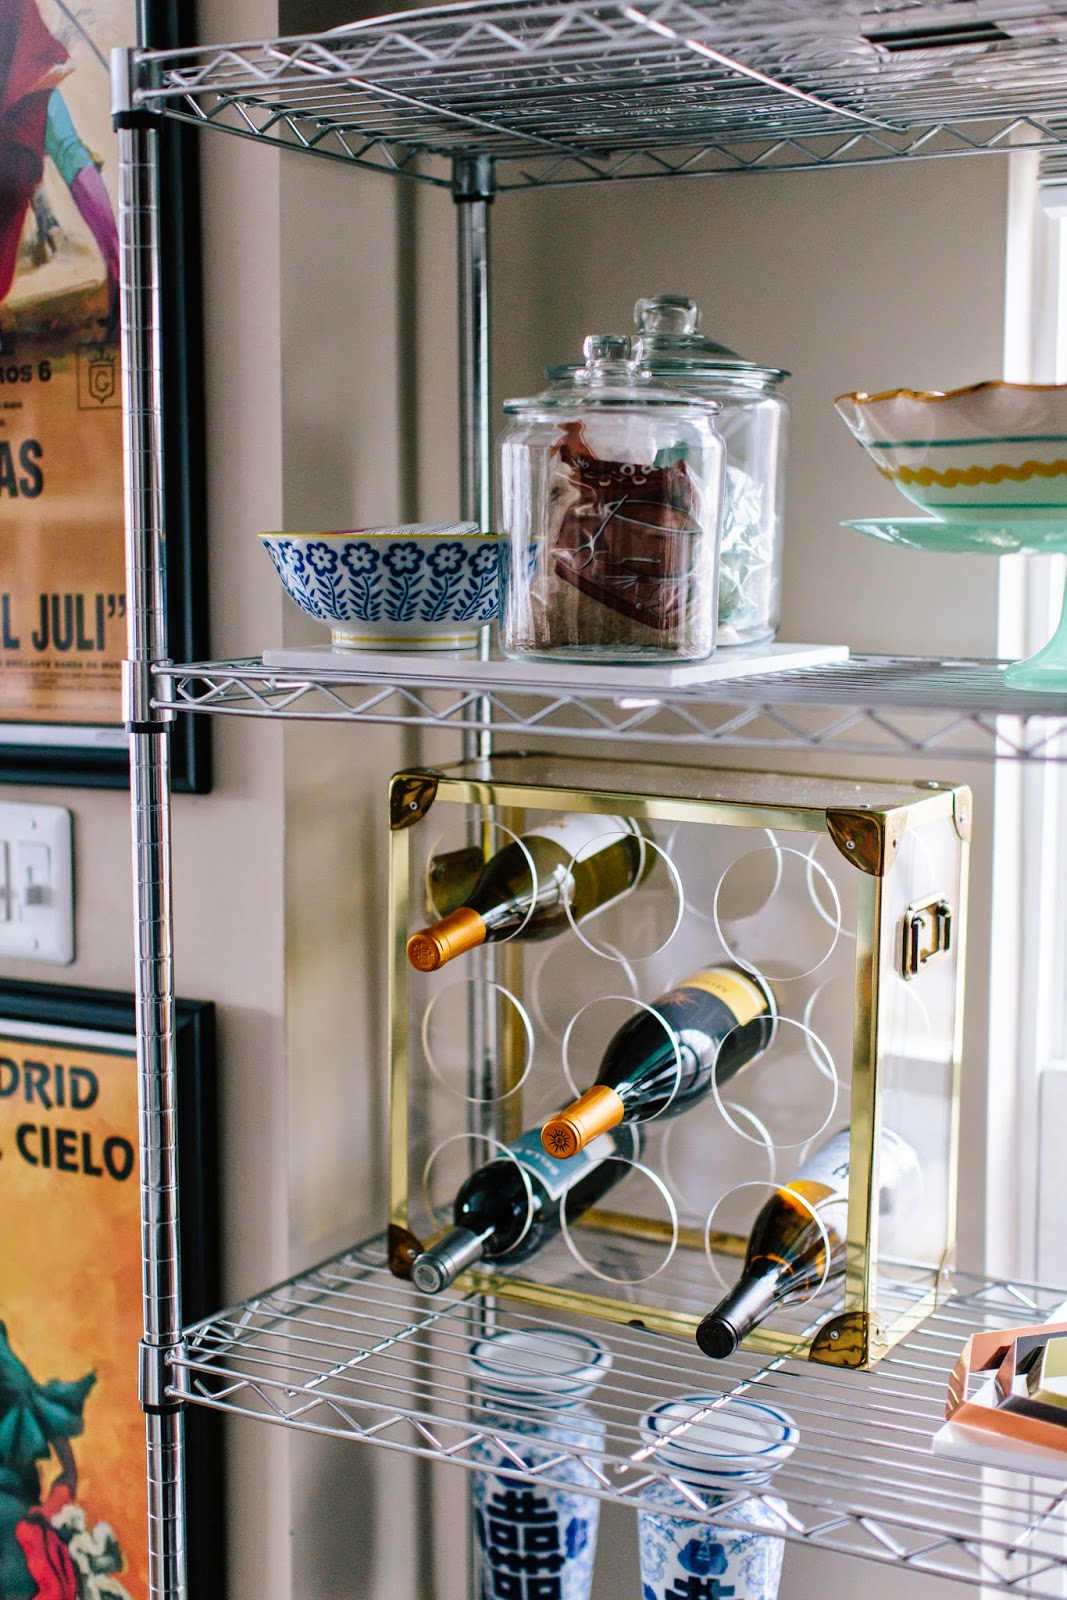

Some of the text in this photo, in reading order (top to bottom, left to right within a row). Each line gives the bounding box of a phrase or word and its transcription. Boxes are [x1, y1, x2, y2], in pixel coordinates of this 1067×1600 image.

[38, 360, 51, 382] 6
[0, 439, 43, 498] AS
[16, 1123, 134, 1181] CIELO
